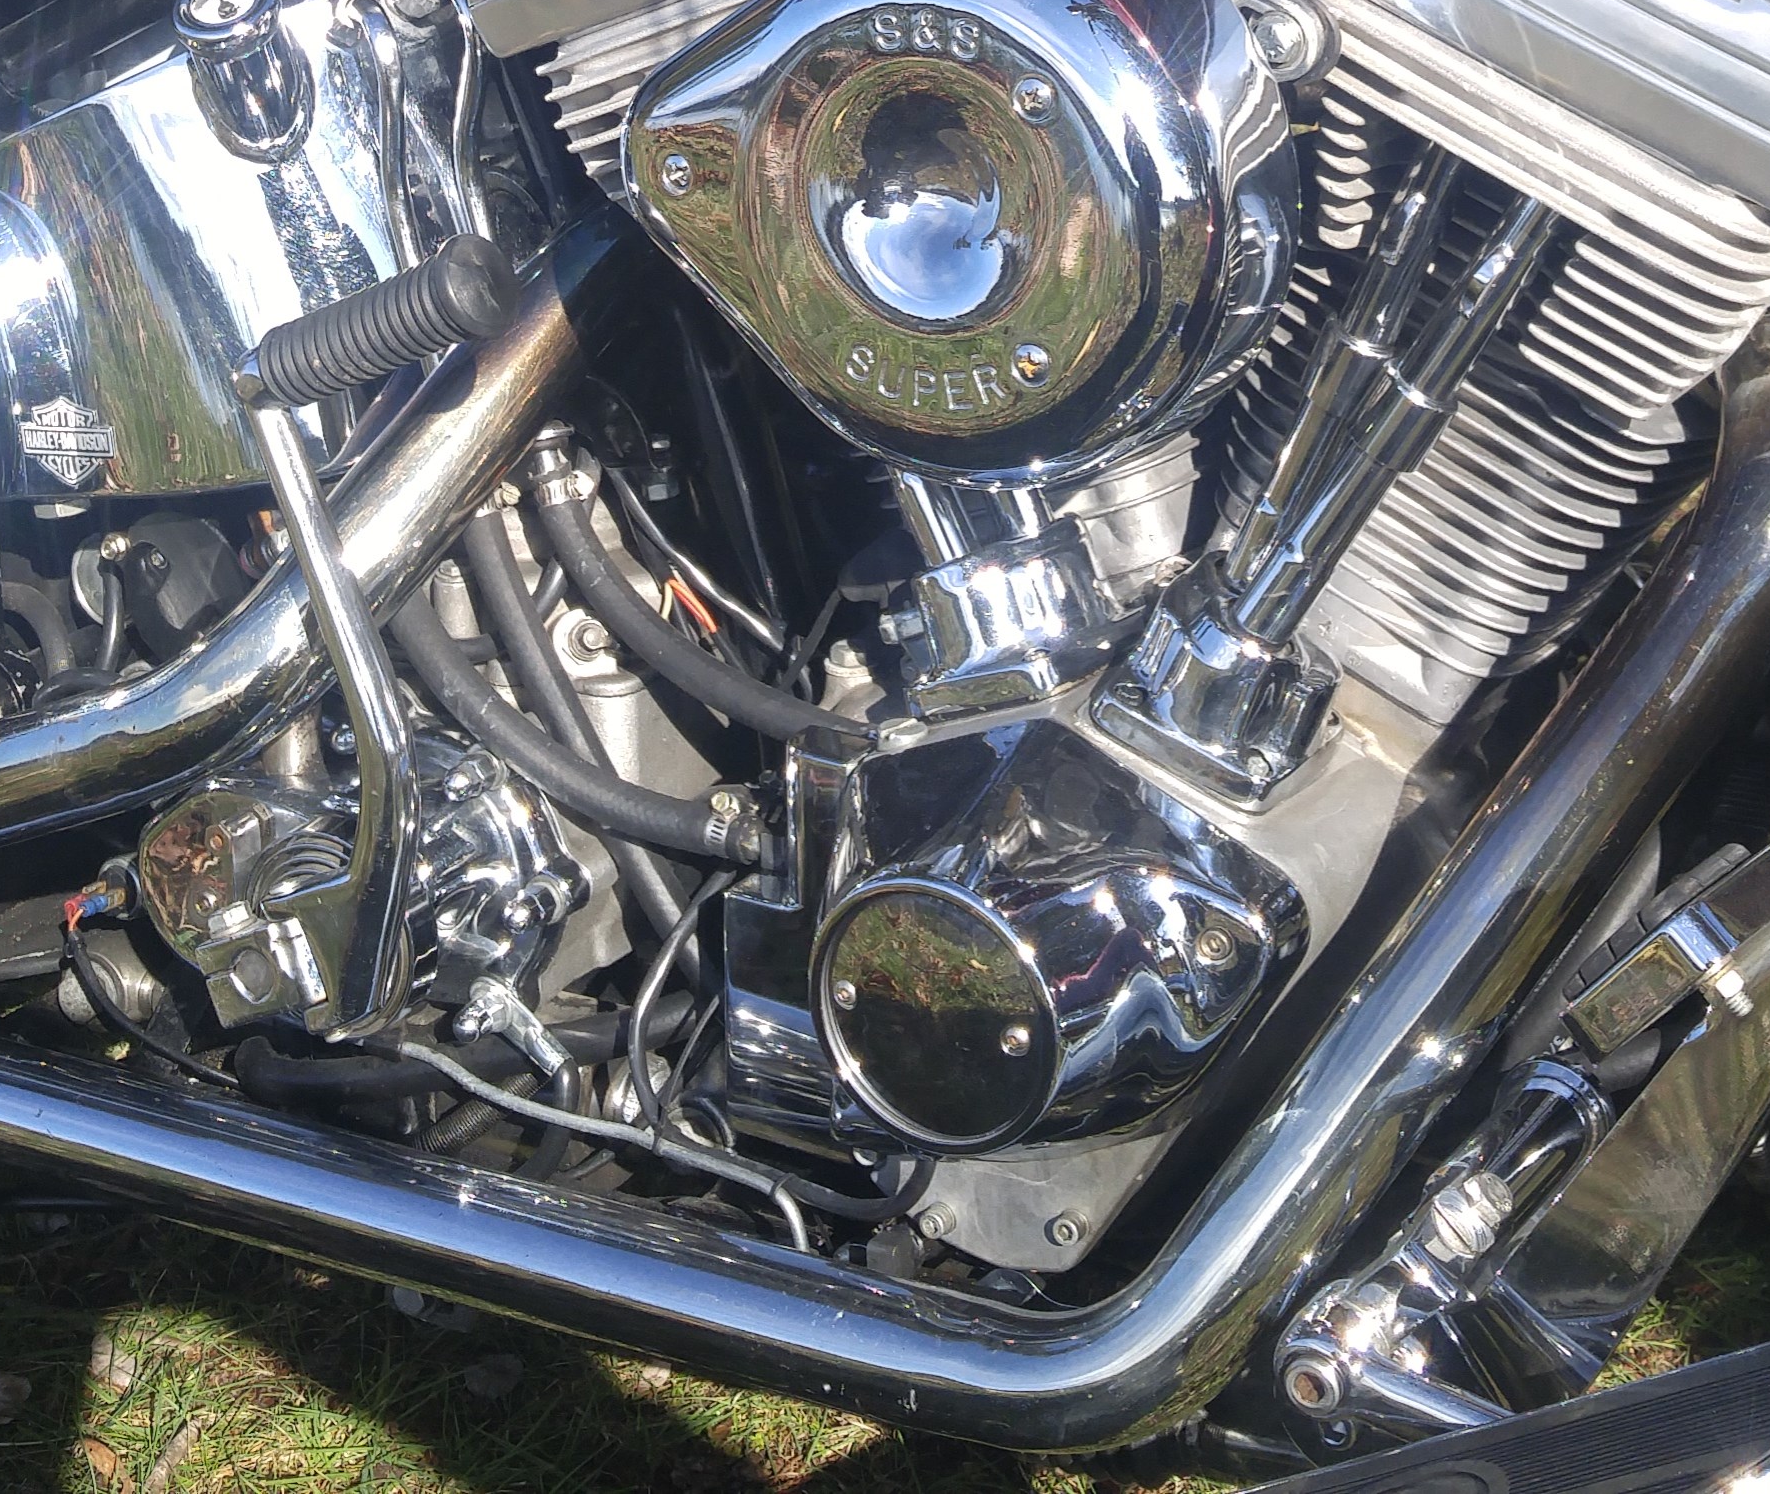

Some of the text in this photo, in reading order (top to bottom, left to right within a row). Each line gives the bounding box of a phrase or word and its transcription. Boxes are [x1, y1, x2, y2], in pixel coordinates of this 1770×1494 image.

[873, 8, 980, 59] S&S
[846, 344, 1007, 410] SUPER
[41, 410, 87, 427] MOTOR
[46, 454, 91, 481] CYCLES
